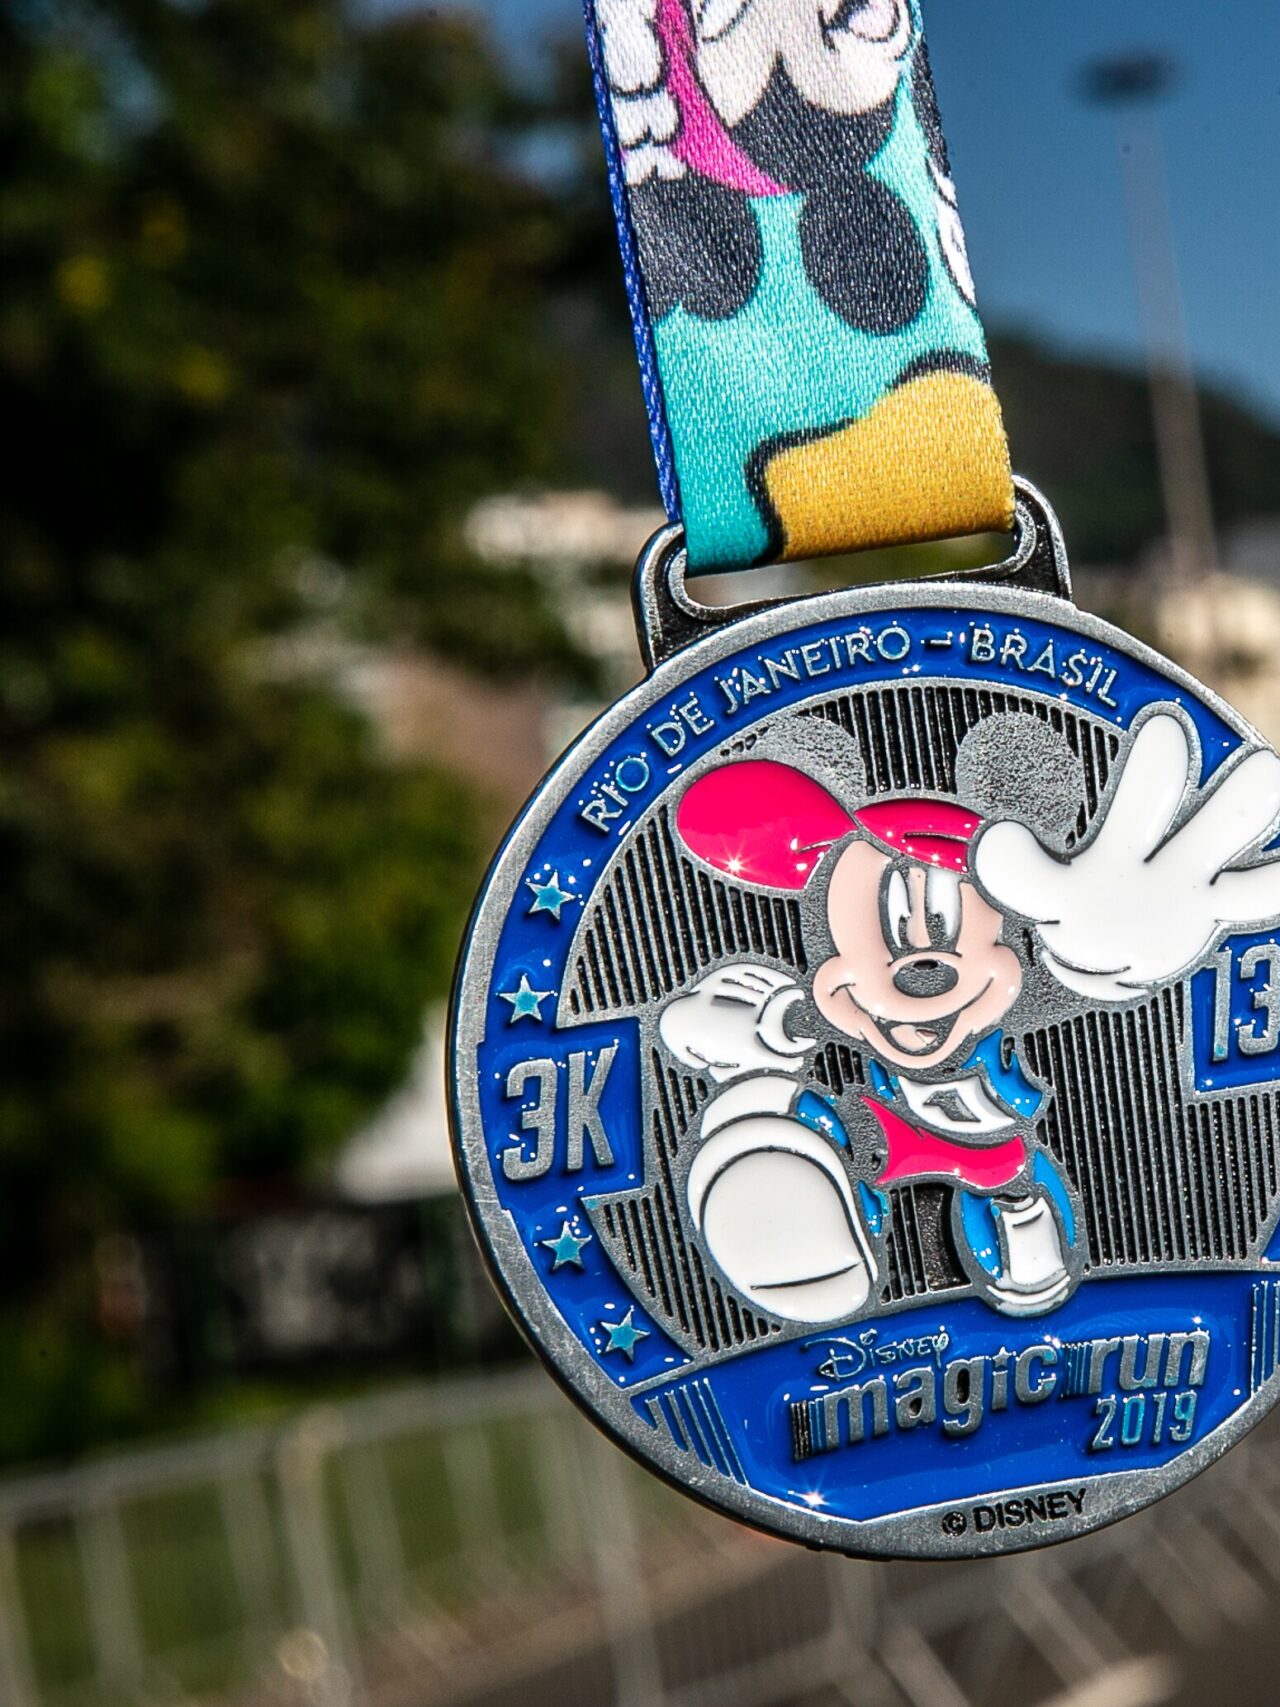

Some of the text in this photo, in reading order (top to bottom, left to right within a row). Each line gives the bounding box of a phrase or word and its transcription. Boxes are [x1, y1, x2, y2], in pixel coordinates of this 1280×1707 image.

[581, 756, 650, 833] RIO
[651, 697, 716, 757] DE
[720, 626, 911, 715] JANEIRO
[970, 626, 1119, 708] BRASIL
[502, 1046, 620, 1182] 3K
[822, 1329, 1211, 1451] magic run
[1091, 1390, 1197, 1452] 2019
[973, 1488, 1087, 1533] DISNEY
